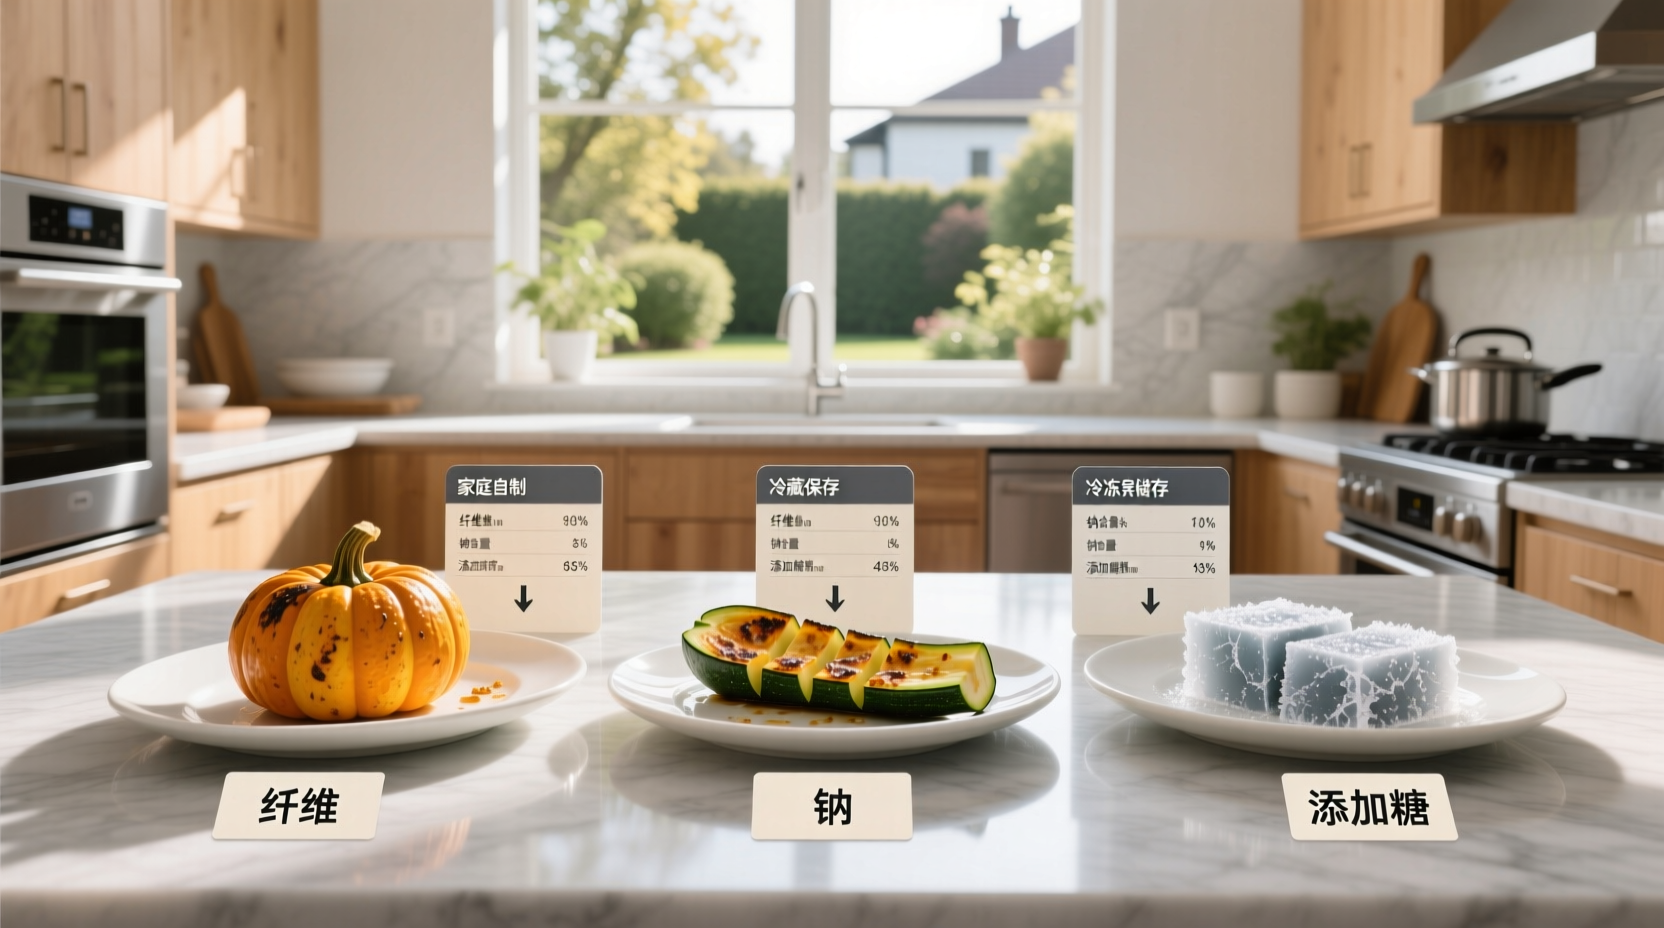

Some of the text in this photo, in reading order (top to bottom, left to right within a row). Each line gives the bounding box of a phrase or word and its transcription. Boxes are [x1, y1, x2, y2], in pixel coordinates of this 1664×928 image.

[458, 477, 526, 496] 家庭自制
[769, 477, 839, 496] 冷藏保存
[258, 786, 340, 826] 纤维
[813, 787, 853, 826] 钠
[1307, 788, 1430, 827] 添加糖
